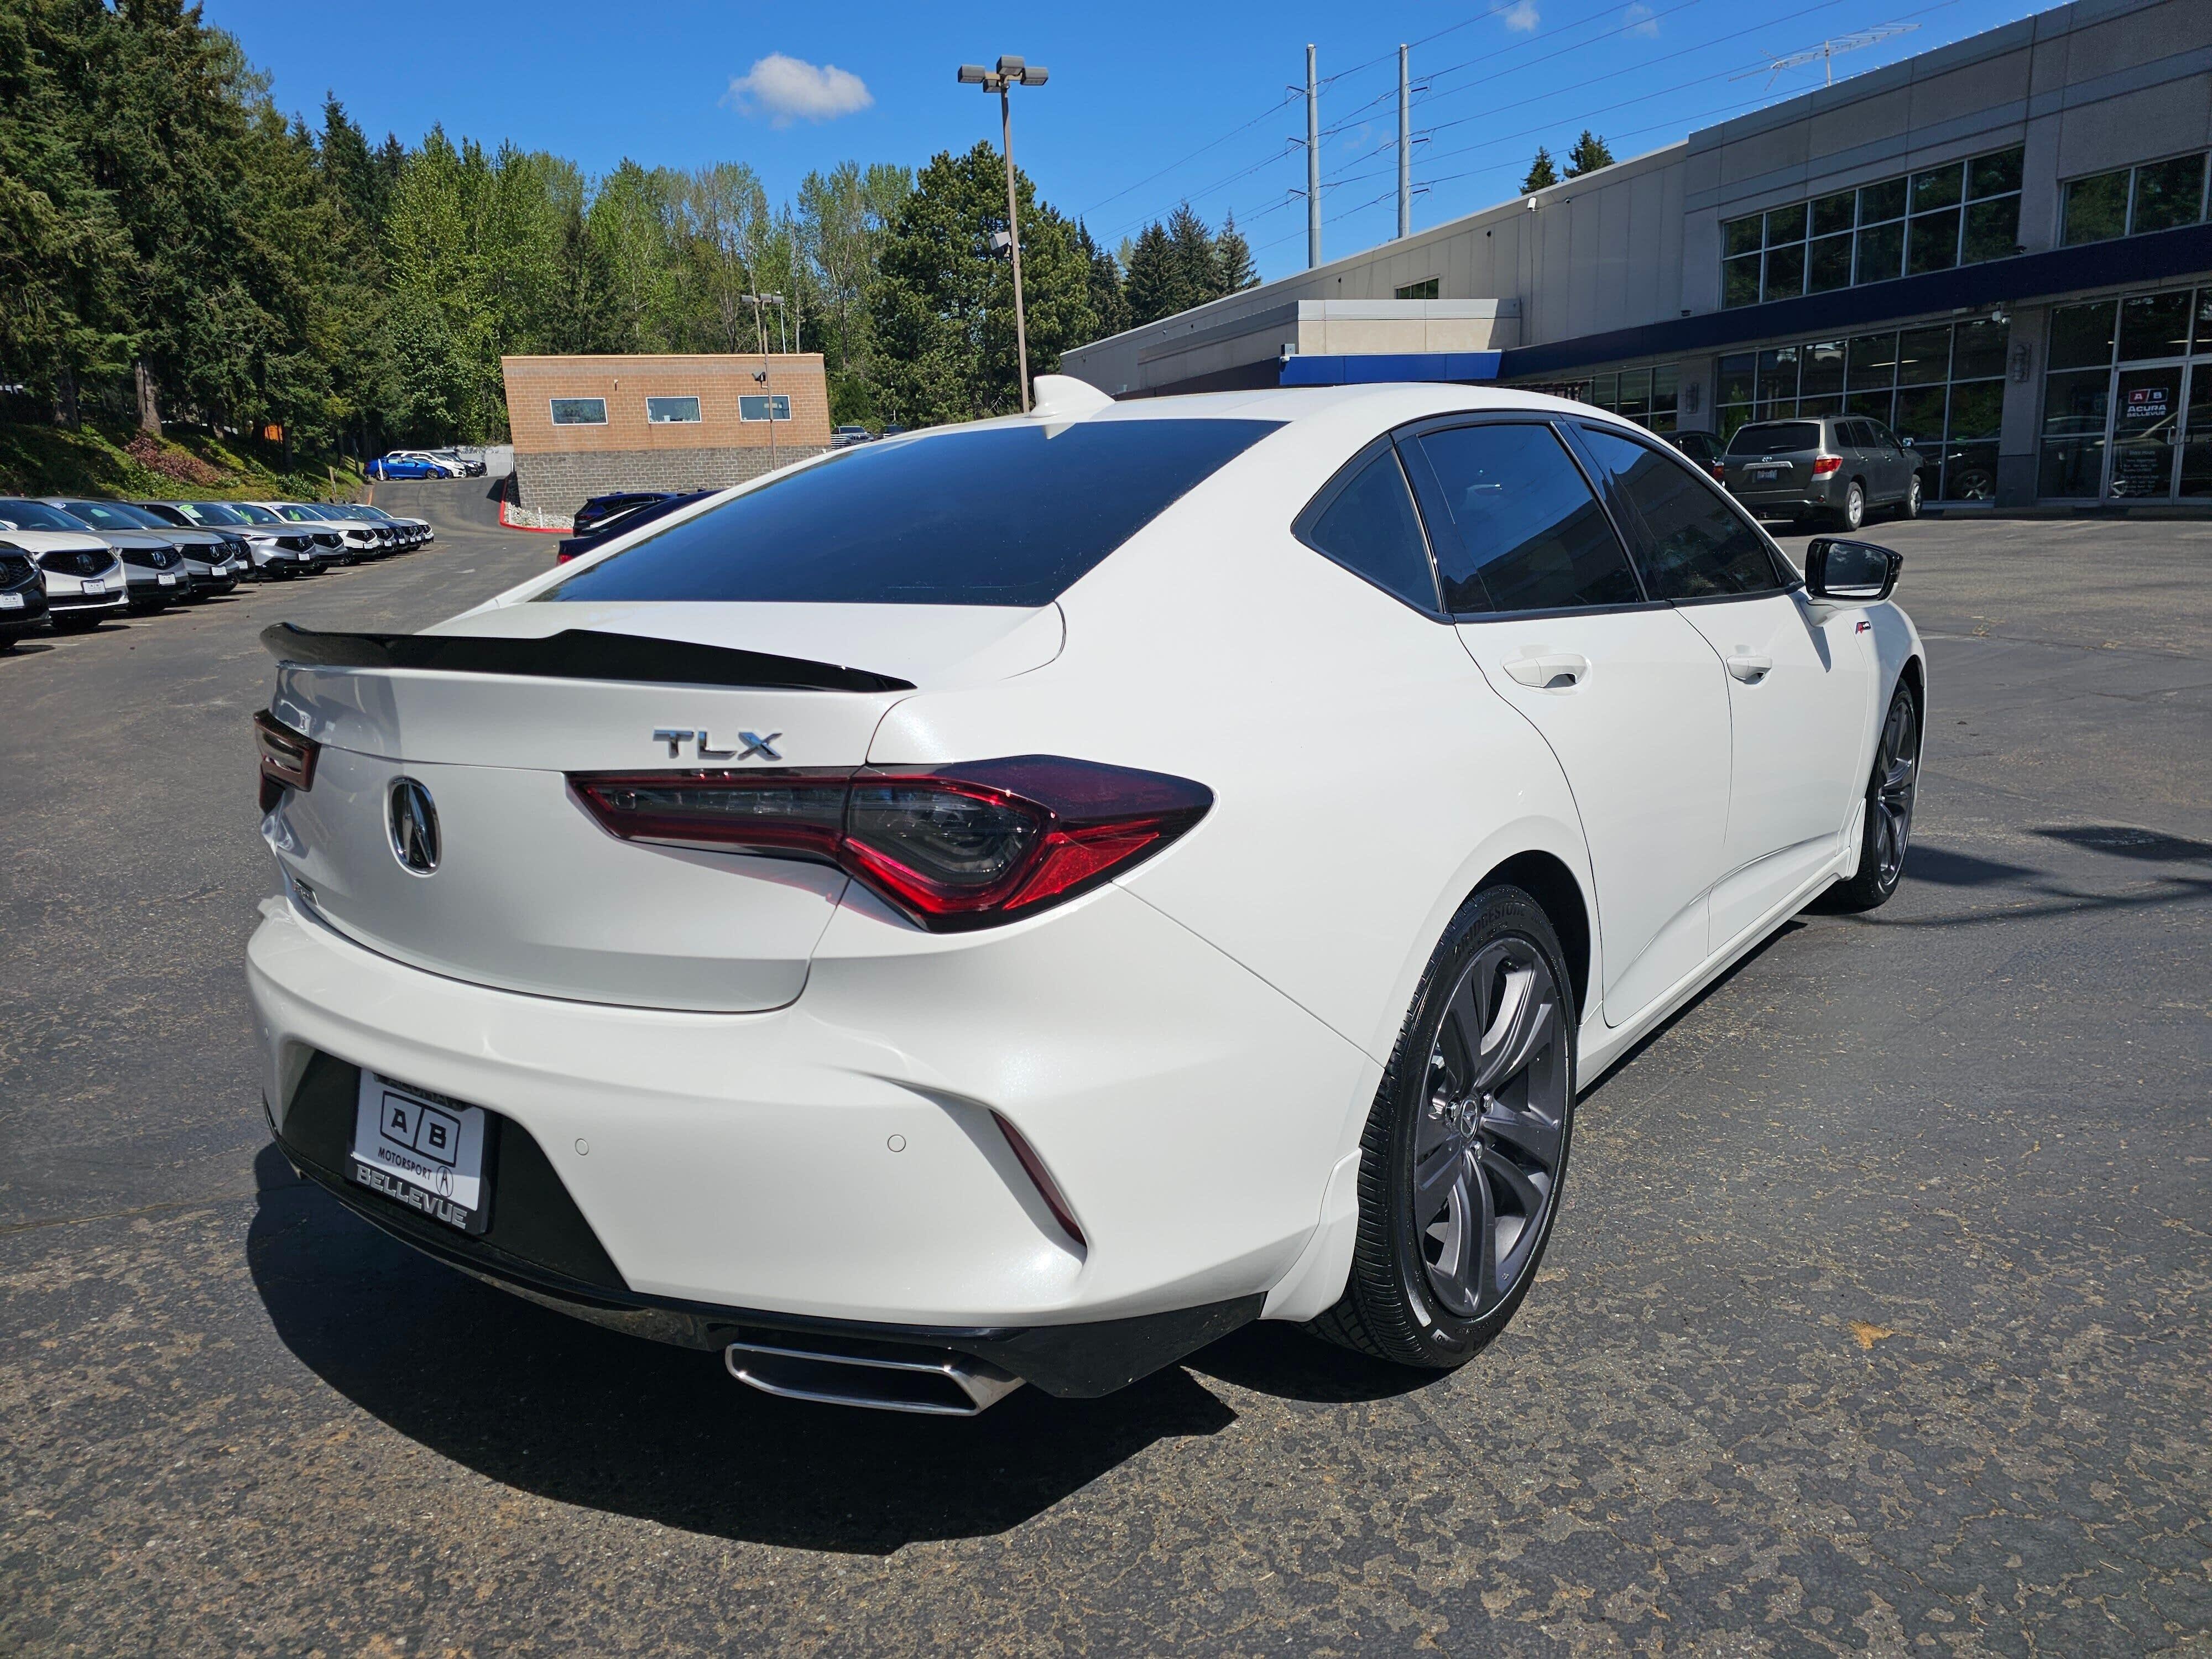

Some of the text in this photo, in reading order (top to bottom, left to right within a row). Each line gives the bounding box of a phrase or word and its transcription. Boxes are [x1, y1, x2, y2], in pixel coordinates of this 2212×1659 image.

[2127, 404, 2167, 413] ACURA
[654, 729, 783, 760] TLX
[390, 1108, 447, 1150] A B
[378, 1147, 432, 1181] MOTORSPORT
[356, 1164, 467, 1229] BELLEVUE
